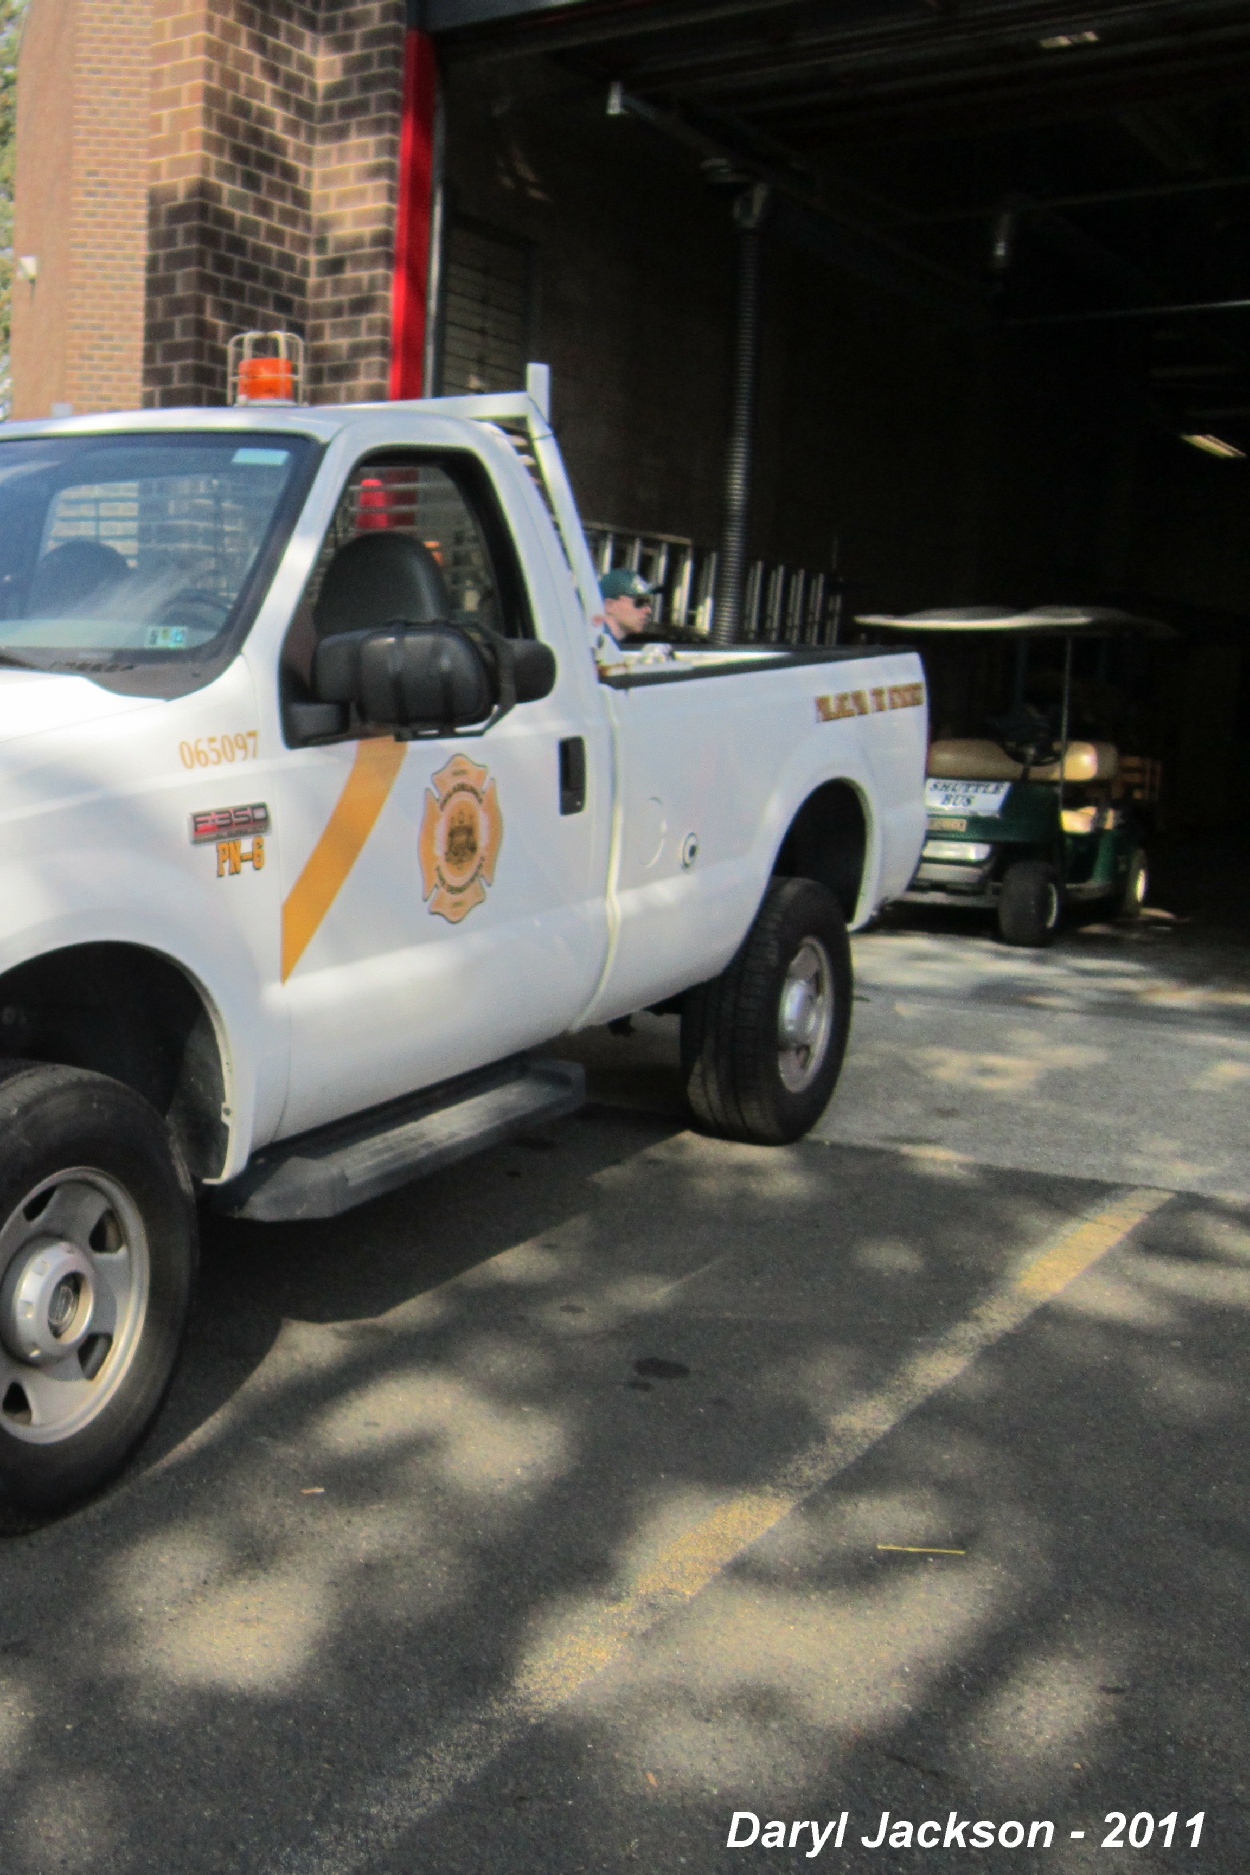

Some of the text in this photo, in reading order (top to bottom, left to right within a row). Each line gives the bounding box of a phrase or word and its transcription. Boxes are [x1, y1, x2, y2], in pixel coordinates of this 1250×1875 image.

[178, 730, 259, 770] 065097
[929, 782, 1006, 795] SHUTTLE
[940, 793, 975, 807] BUS
[216, 835, 265, 878] PN-6
